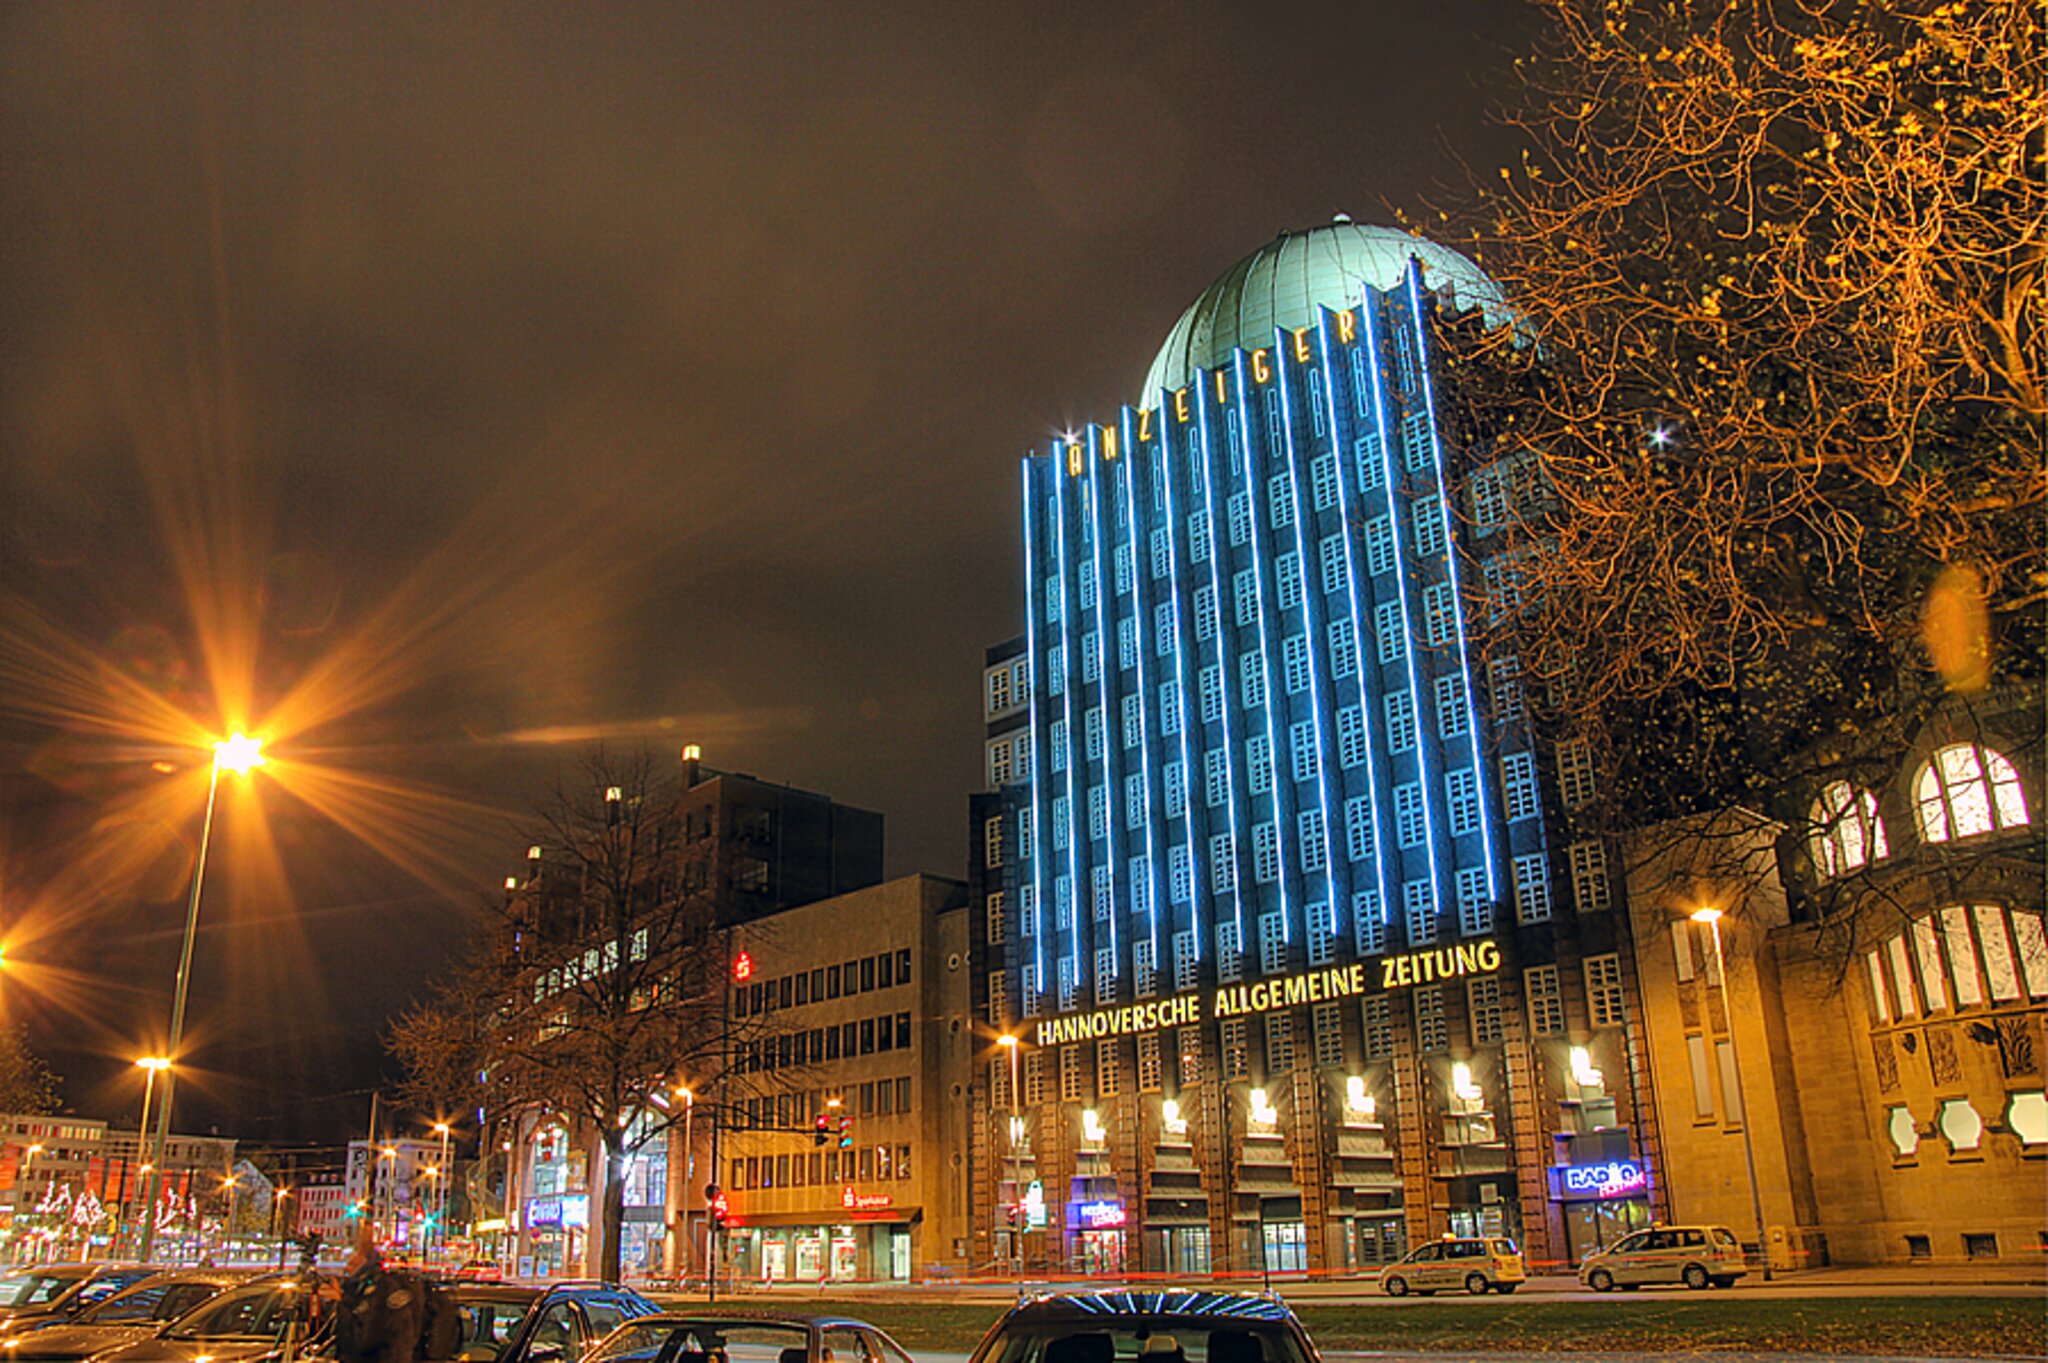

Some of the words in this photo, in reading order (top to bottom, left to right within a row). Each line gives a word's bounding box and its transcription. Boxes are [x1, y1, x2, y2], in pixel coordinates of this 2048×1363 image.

[1068, 309, 1355, 477] ANZEIGER
[1036, 995, 1200, 1047] HANNOVERSCHE
[1213, 963, 1365, 1019] ALLGEMEINE
[1380, 940, 1501, 988] ZEITUNG
